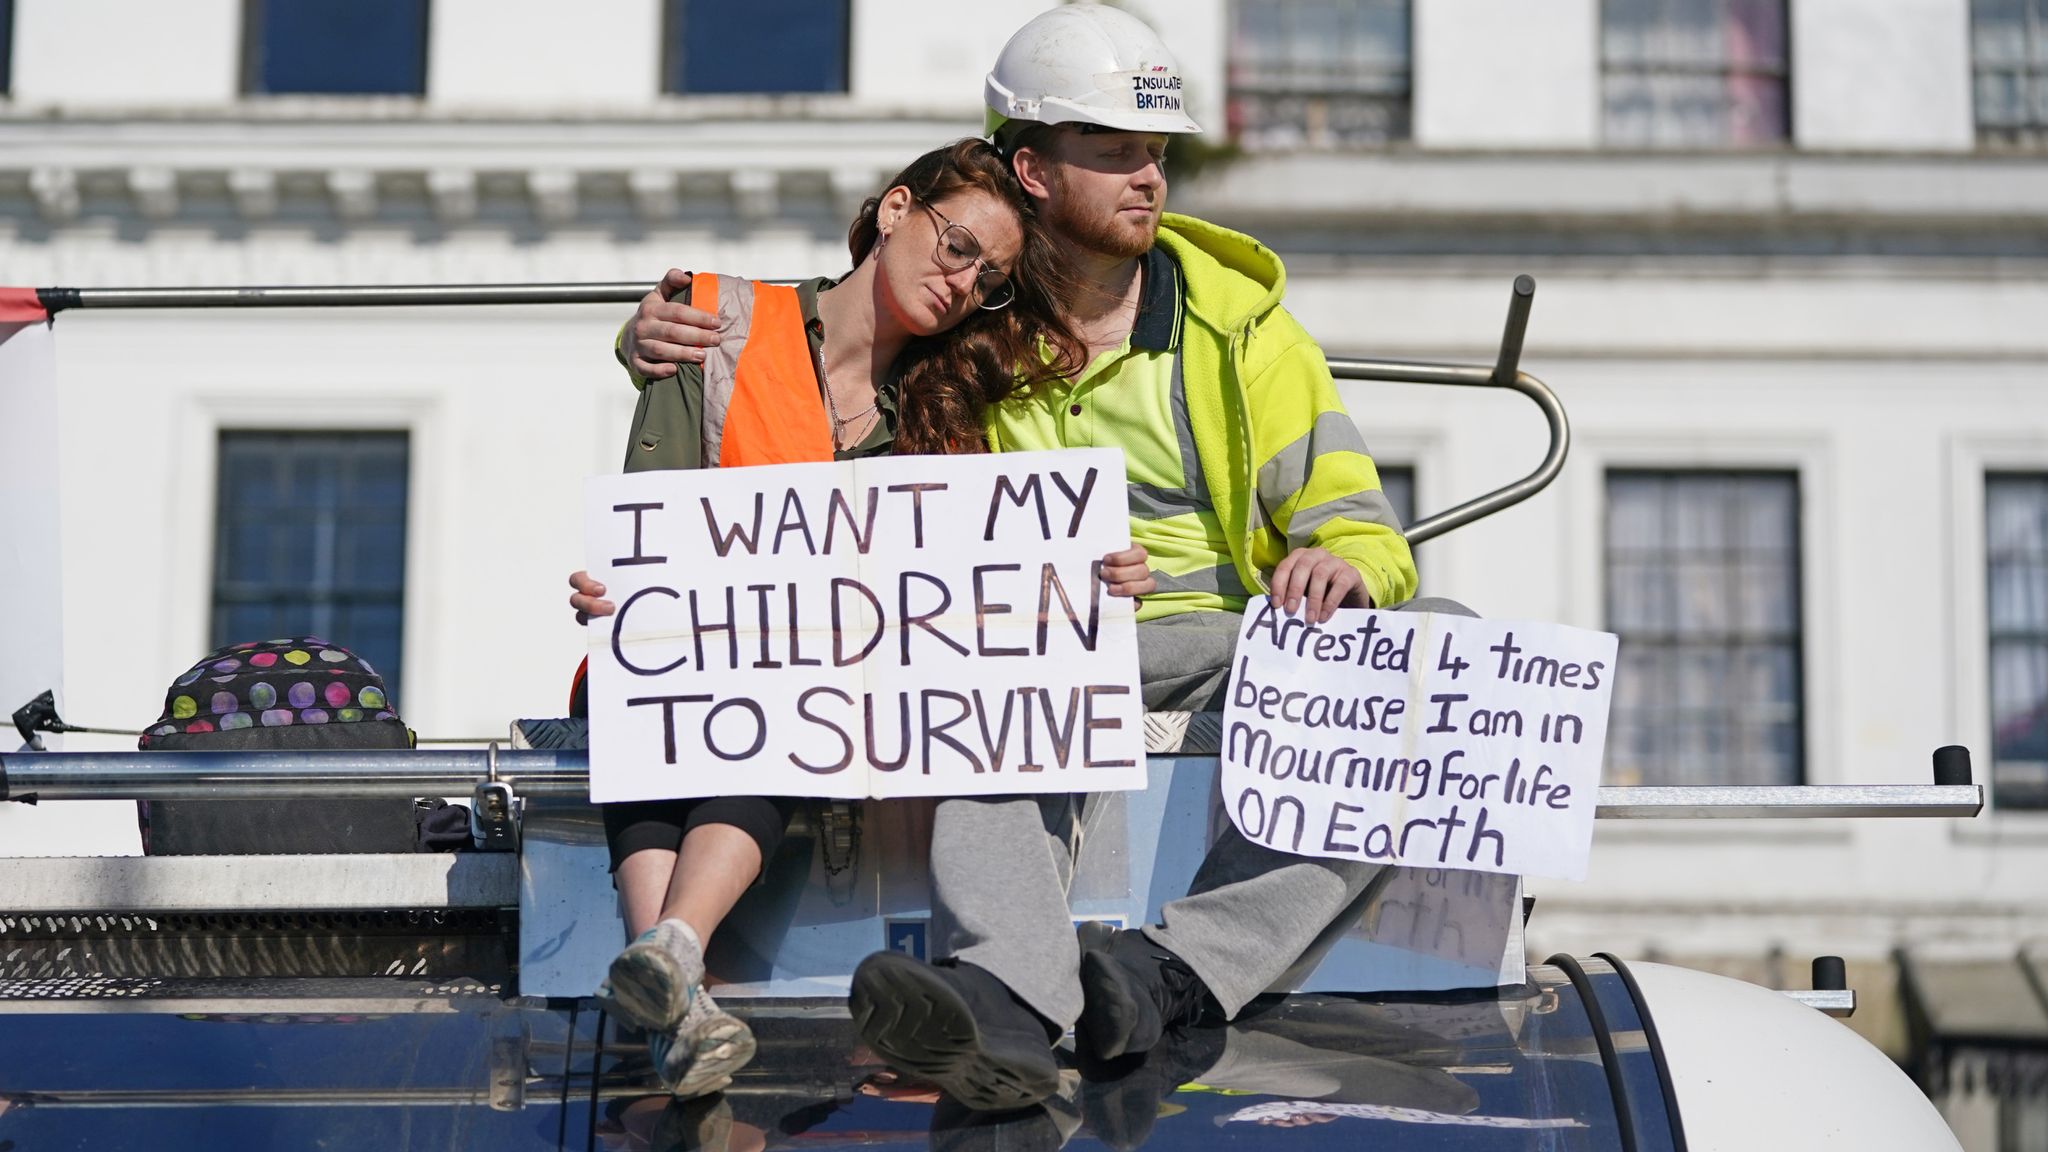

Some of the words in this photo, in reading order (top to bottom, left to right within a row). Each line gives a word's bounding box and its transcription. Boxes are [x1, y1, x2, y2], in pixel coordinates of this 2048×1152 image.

[1136, 92, 1180, 110] BRITAIN
[612, 502, 668, 567] I
[700, 483, 949, 558] WANT
[983, 467, 1099, 542] MY
[611, 559, 1104, 676] CHILDREN
[1245, 602, 1414, 673] Arrested
[1438, 632, 1470, 680] 4
[1490, 632, 1605, 691] times
[627, 694, 767, 765] TO
[788, 685, 1136, 775] SURVIVE
[1234, 656, 1406, 735] because
[1426, 694, 1469, 734] I
[1469, 710, 1523, 738] am
[1540, 713, 1583, 744] in
[1503, 758, 1572, 809] life
[1323, 802, 1505, 867] Earth
